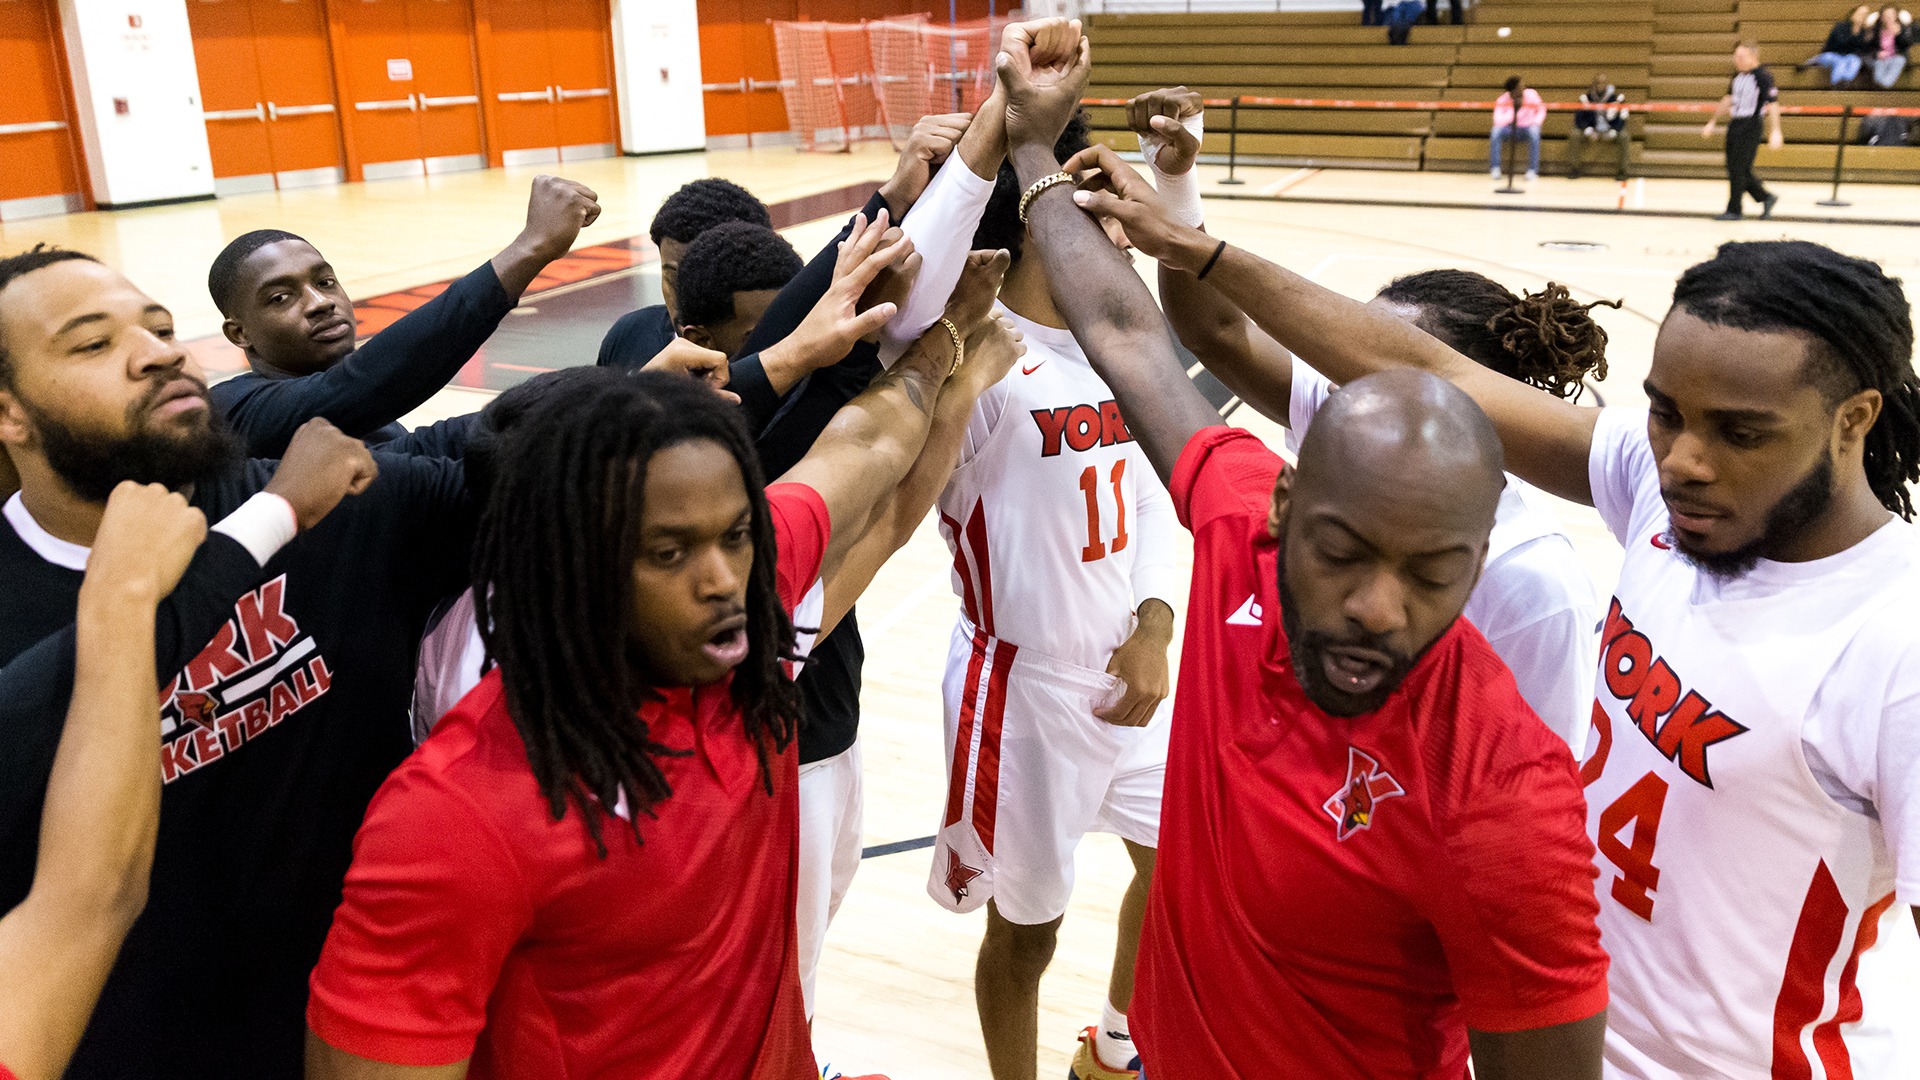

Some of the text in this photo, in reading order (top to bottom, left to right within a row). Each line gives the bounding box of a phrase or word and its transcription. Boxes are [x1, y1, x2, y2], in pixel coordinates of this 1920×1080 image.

[1029, 398, 1136, 458] YOR
[1079, 458, 1129, 563] 11
[160, 573, 300, 711] RK
[1597, 594, 1751, 791] YORK
[161, 654, 334, 785] KETBALL
